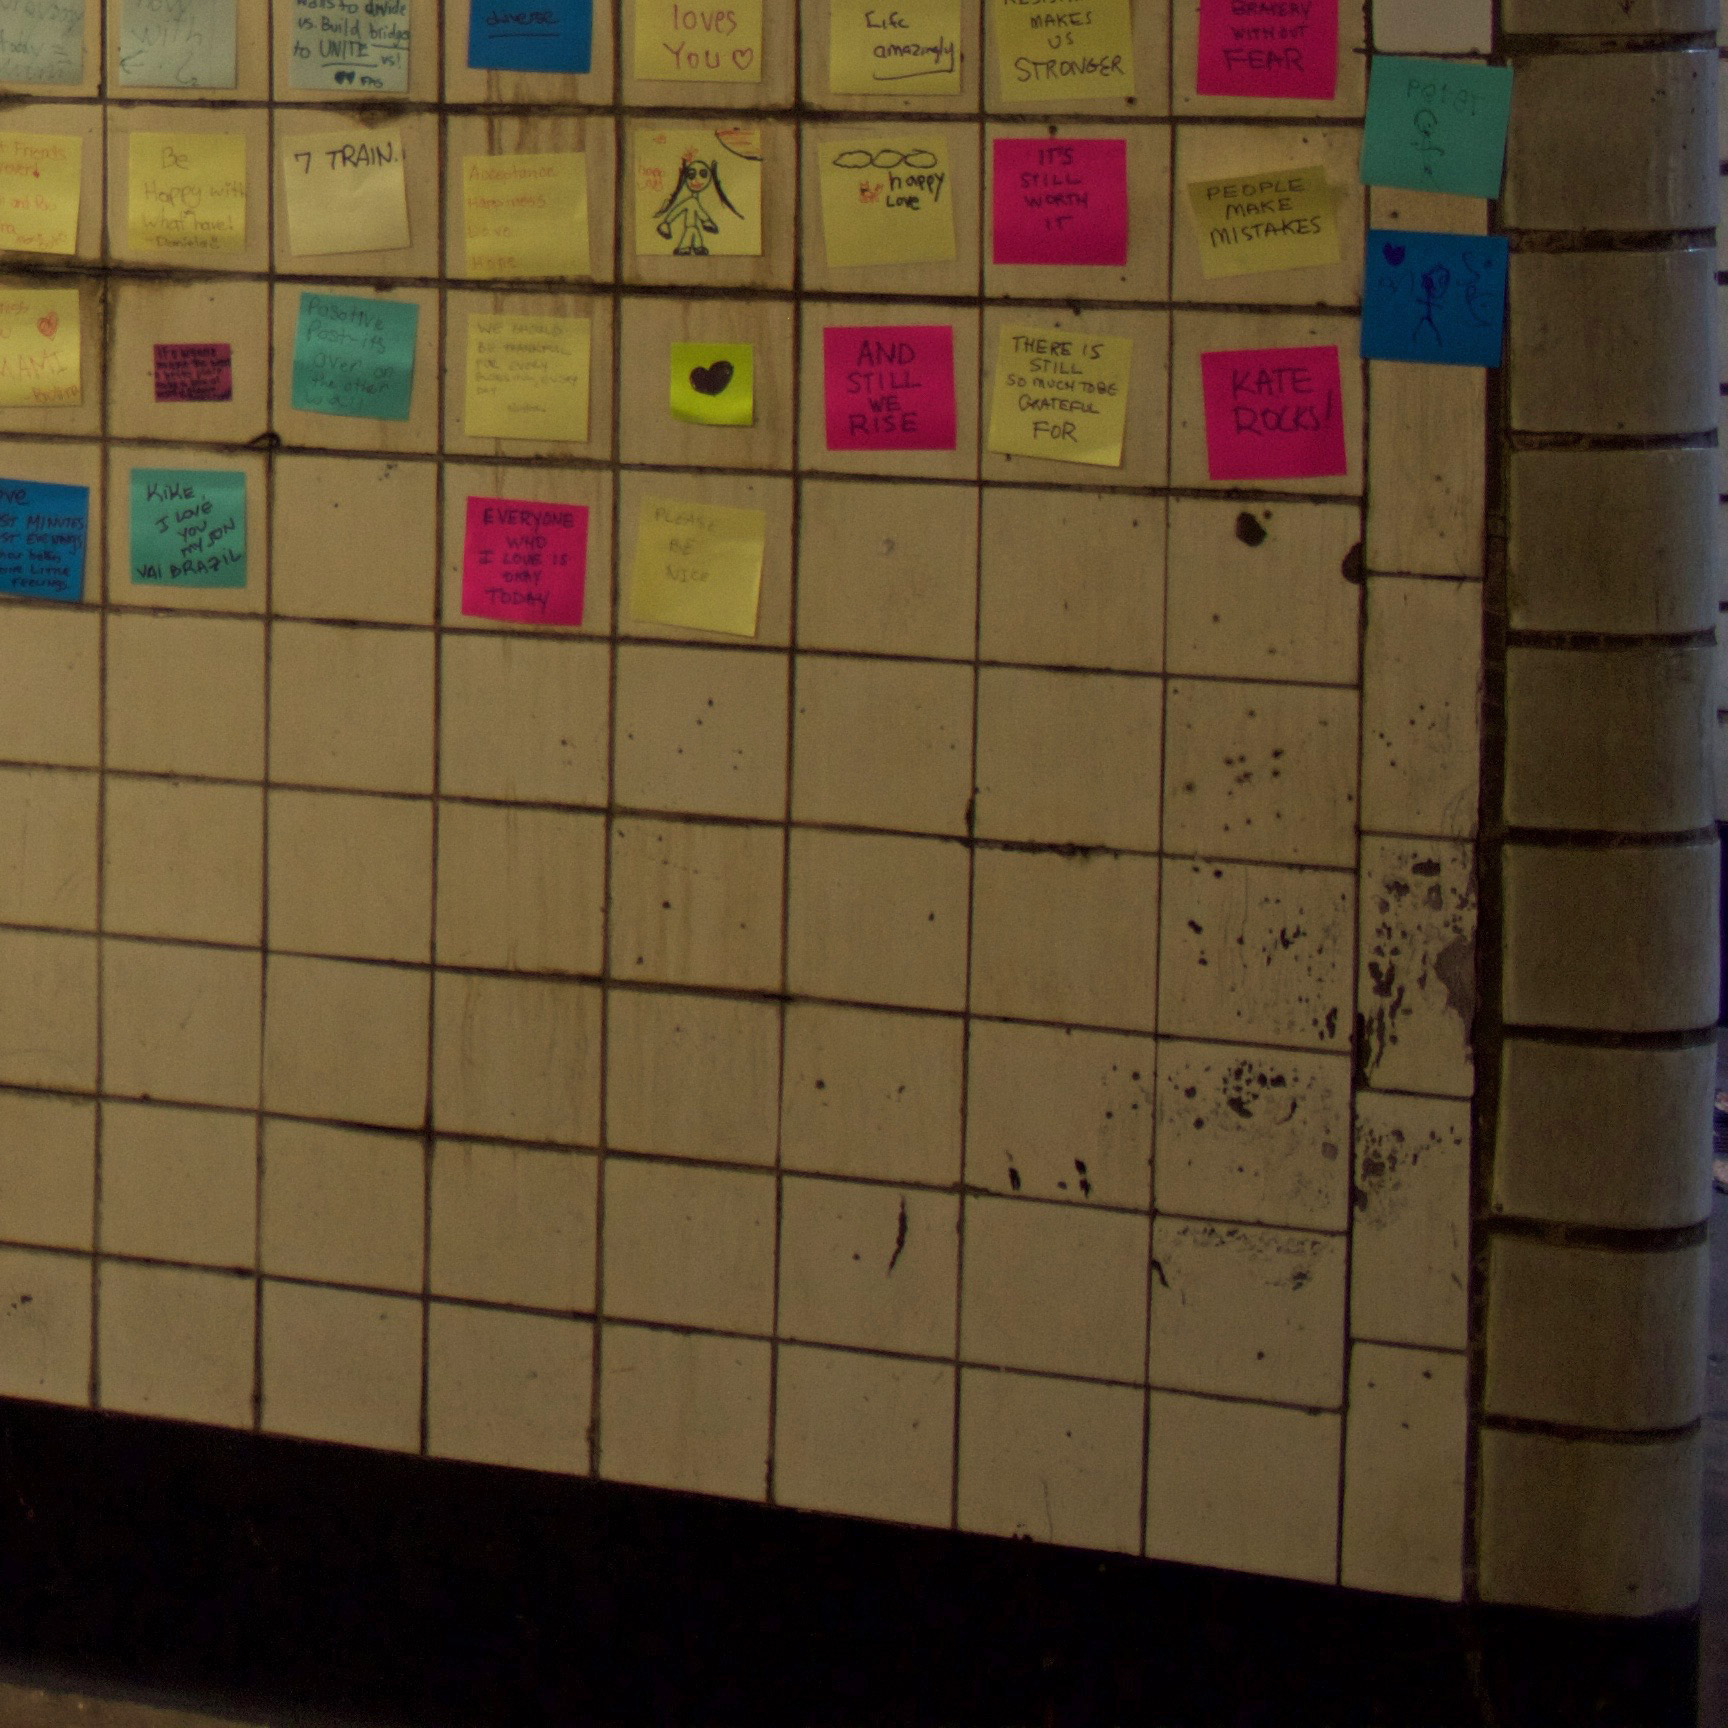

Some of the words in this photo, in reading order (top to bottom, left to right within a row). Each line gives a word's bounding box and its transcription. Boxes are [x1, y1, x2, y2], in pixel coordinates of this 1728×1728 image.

[1028, 10, 1093, 28] MAKES
[1047, 32, 1074, 49] US
[1013, 55, 1125, 82] STRONGER
[1206, 176, 1306, 203] PEOPLE
[1224, 197, 1294, 219] MAKE
[1208, 216, 1323, 249] MISTAKES
[854, 339, 916, 367] AND
[845, 370, 922, 395] STILL
[1231, 365, 1314, 398] KATE
[866, 393, 902, 416] WE
[847, 411, 921, 436] RISE
